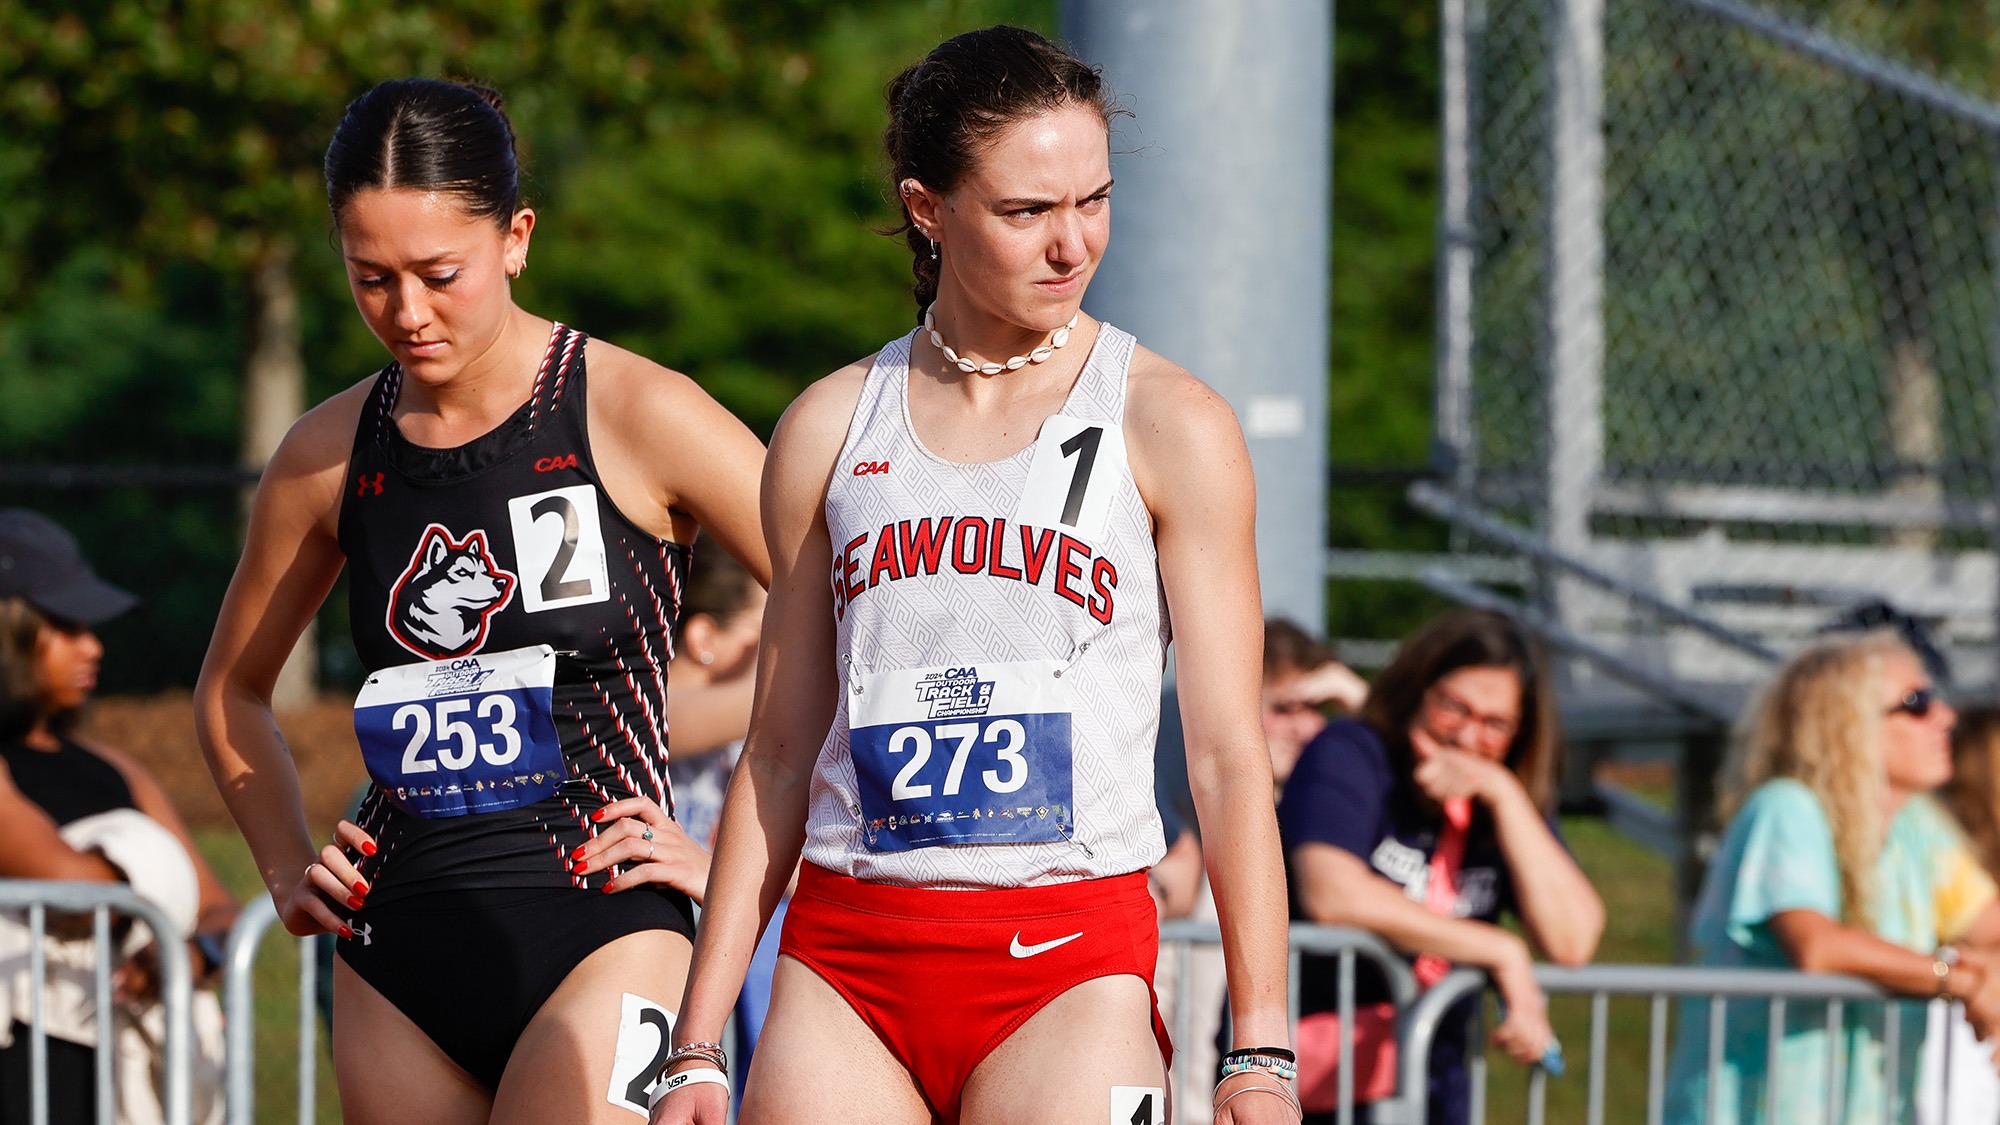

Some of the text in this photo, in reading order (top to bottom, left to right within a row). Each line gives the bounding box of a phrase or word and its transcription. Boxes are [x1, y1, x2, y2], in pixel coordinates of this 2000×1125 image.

[534, 453, 579, 473] CAA
[853, 461, 890, 477] CAA
[1060, 426, 1104, 528] 1
[530, 495, 593, 602] 2
[831, 516, 1118, 626] SEAWOLVES
[451, 658, 480, 671] CAA
[935, 679, 977, 687] OUTDOOR
[944, 667, 978, 679] CAA
[392, 694, 522, 775] 253
[888, 718, 1029, 802] 273
[624, 1007, 670, 1111] 2
